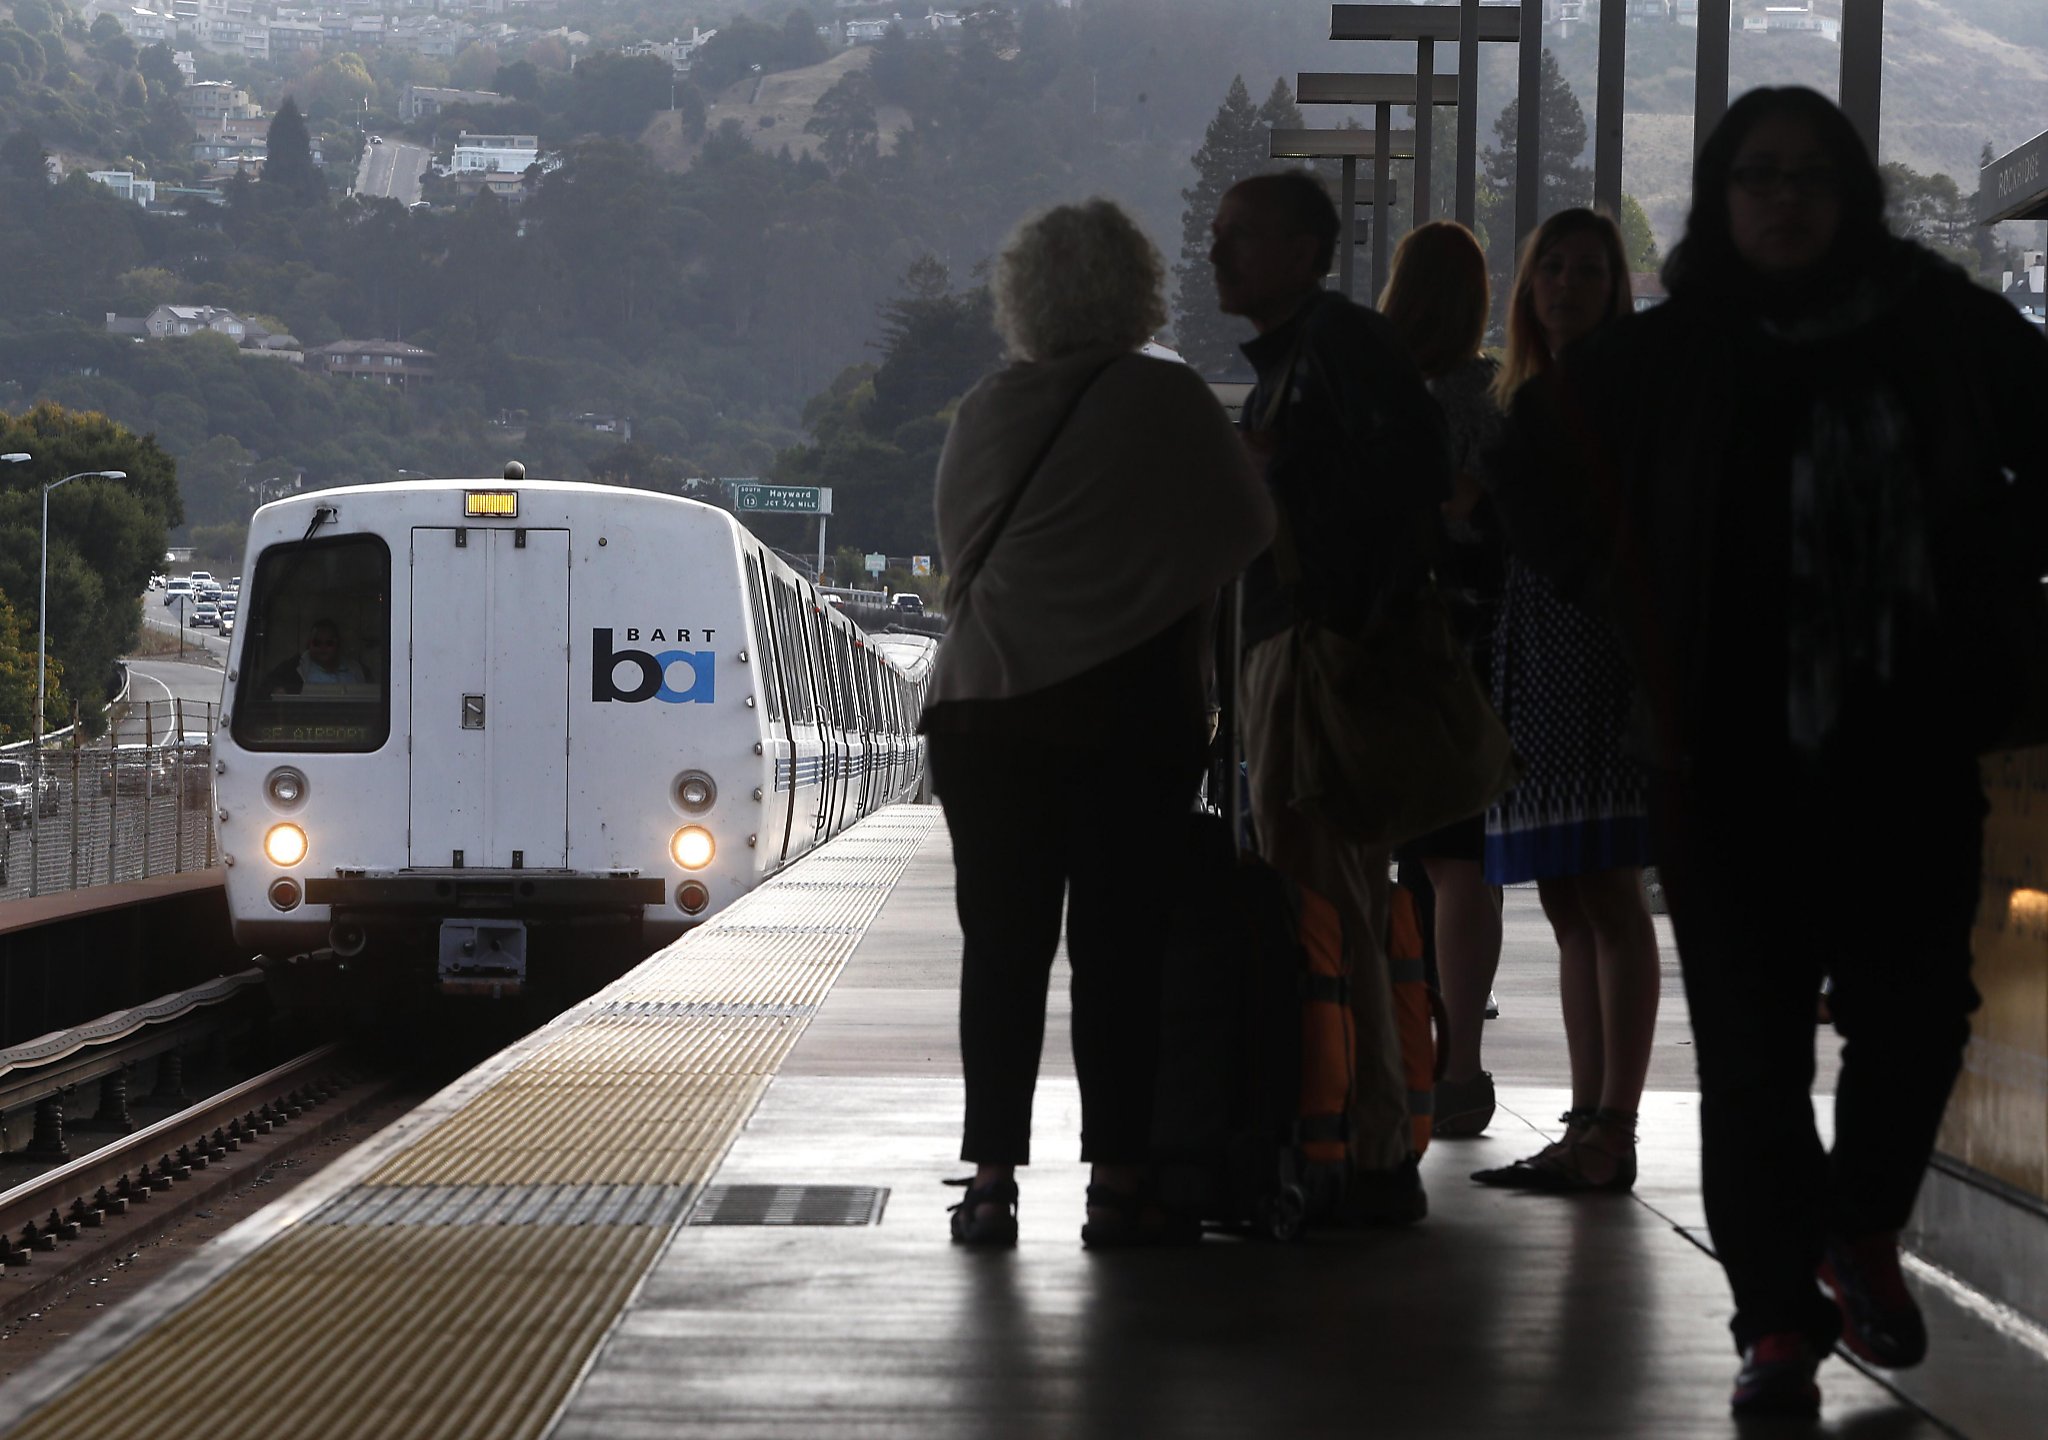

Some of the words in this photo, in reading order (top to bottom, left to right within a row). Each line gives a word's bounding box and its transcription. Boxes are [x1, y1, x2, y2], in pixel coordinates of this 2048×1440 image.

[769, 489, 811, 499] Hayward
[746, 498, 755, 506] 13
[627, 628, 715, 642] BART
